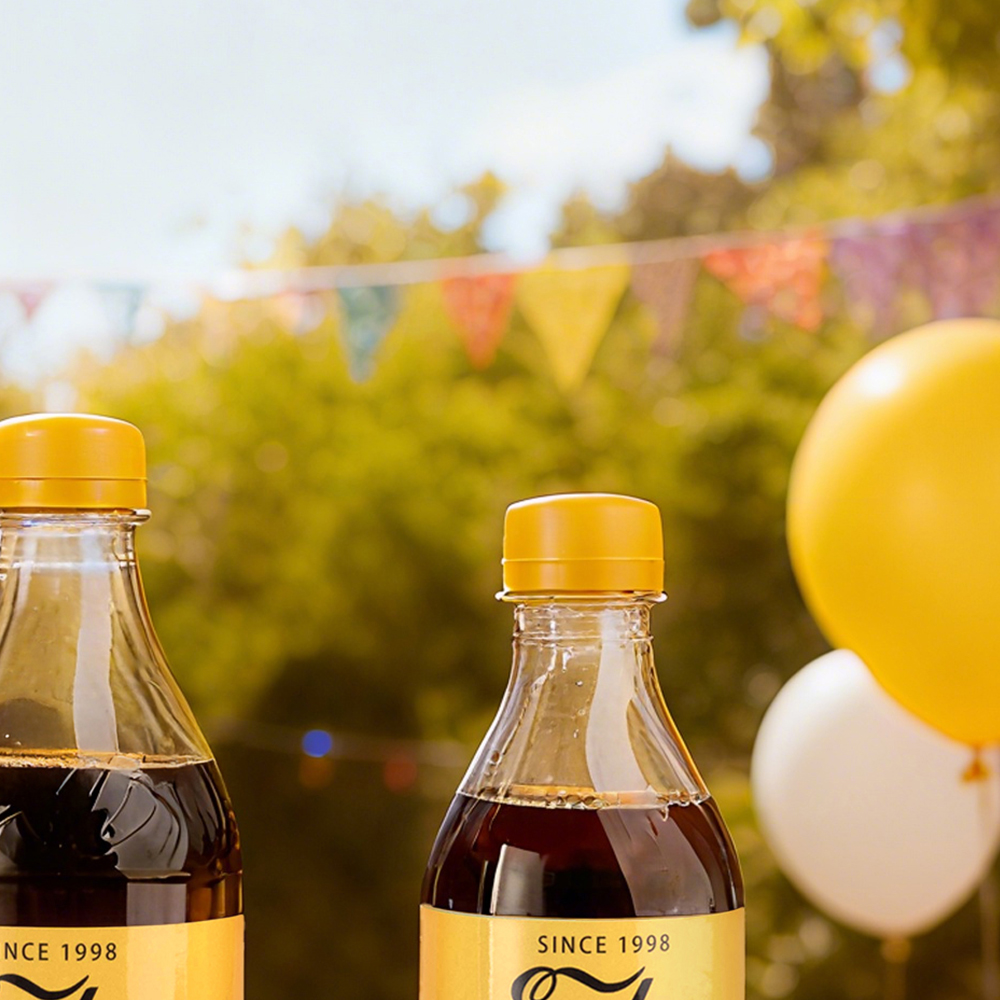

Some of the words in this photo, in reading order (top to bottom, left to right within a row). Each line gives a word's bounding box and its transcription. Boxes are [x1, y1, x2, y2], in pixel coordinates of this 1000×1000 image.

[61, 942, 117, 961] 1998
[538, 935, 607, 955] SINCE
[619, 934, 670, 954] 1998
